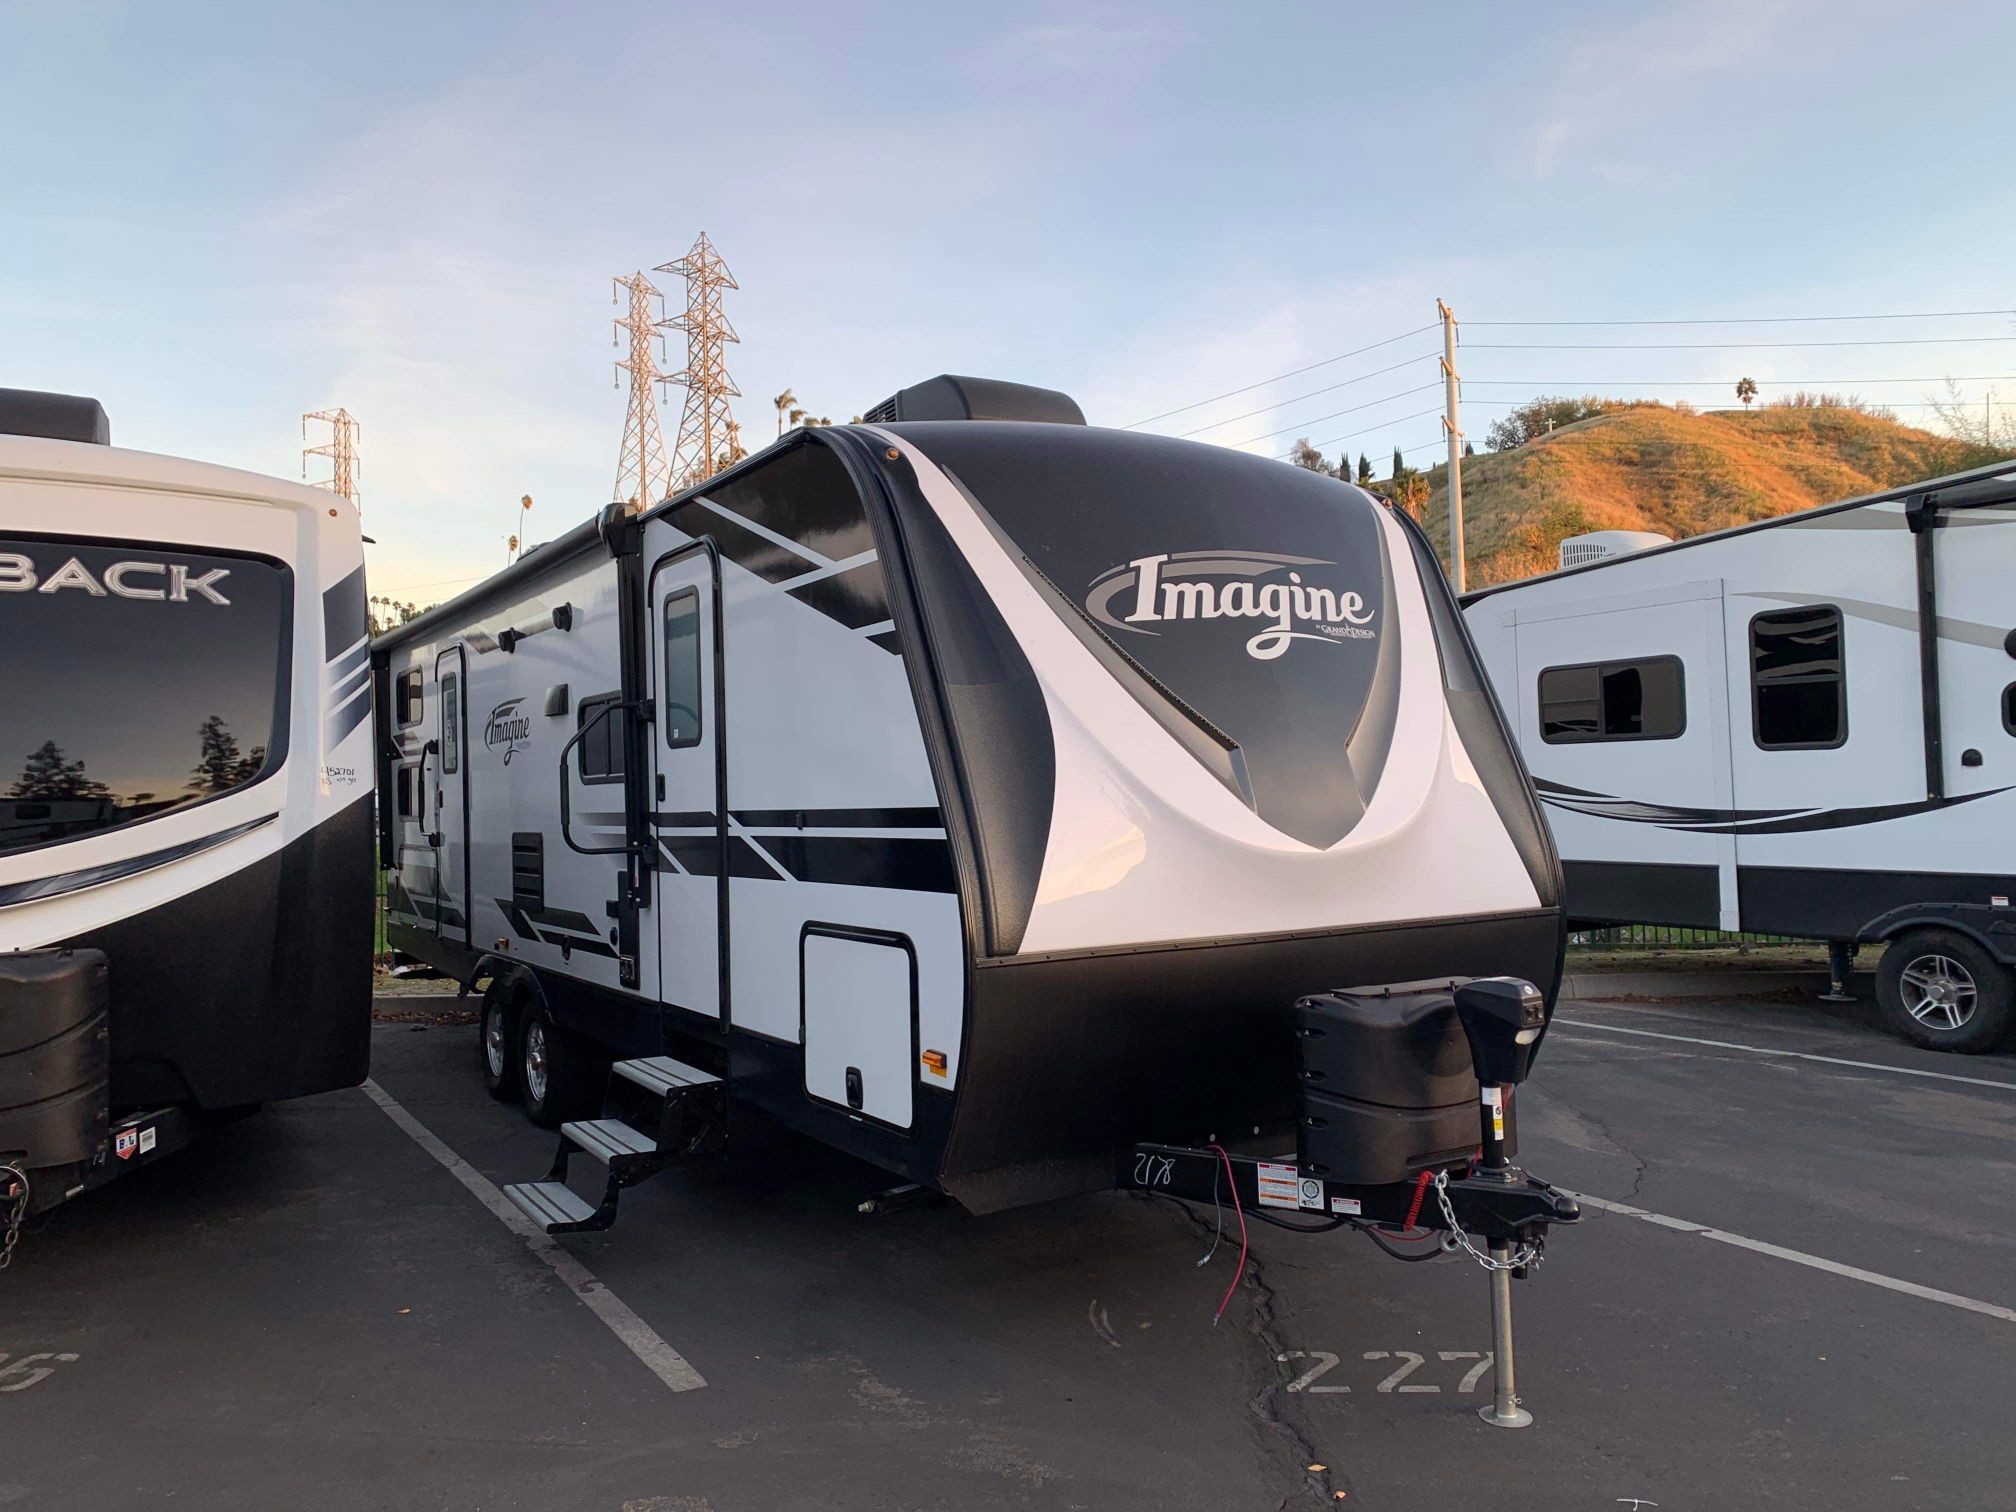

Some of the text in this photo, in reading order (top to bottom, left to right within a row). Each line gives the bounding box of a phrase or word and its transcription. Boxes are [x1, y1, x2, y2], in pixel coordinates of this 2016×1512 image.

[0, 552, 232, 605] BACK
[1125, 554, 1375, 659] Imagine
[489, 707, 531, 766] Imagine
[1279, 1351, 1494, 1392] 227
